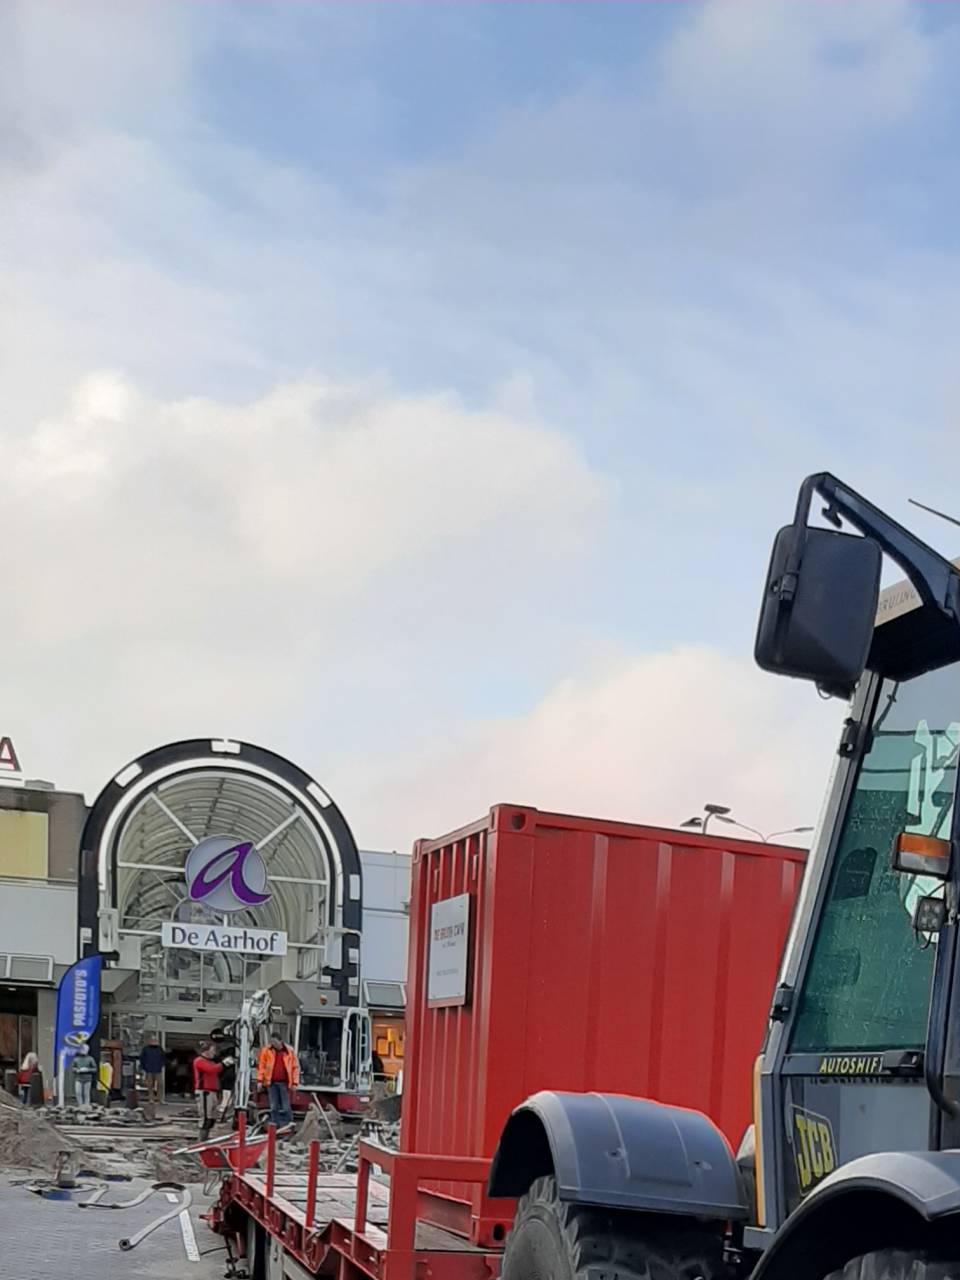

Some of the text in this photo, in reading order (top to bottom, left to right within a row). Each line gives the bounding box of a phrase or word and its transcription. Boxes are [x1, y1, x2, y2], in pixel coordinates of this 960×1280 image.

[171, 926, 279, 952] De Aarhof
[73, 969, 88, 1027] PASFOTO'S
[795, 1113, 834, 1188] JCB
